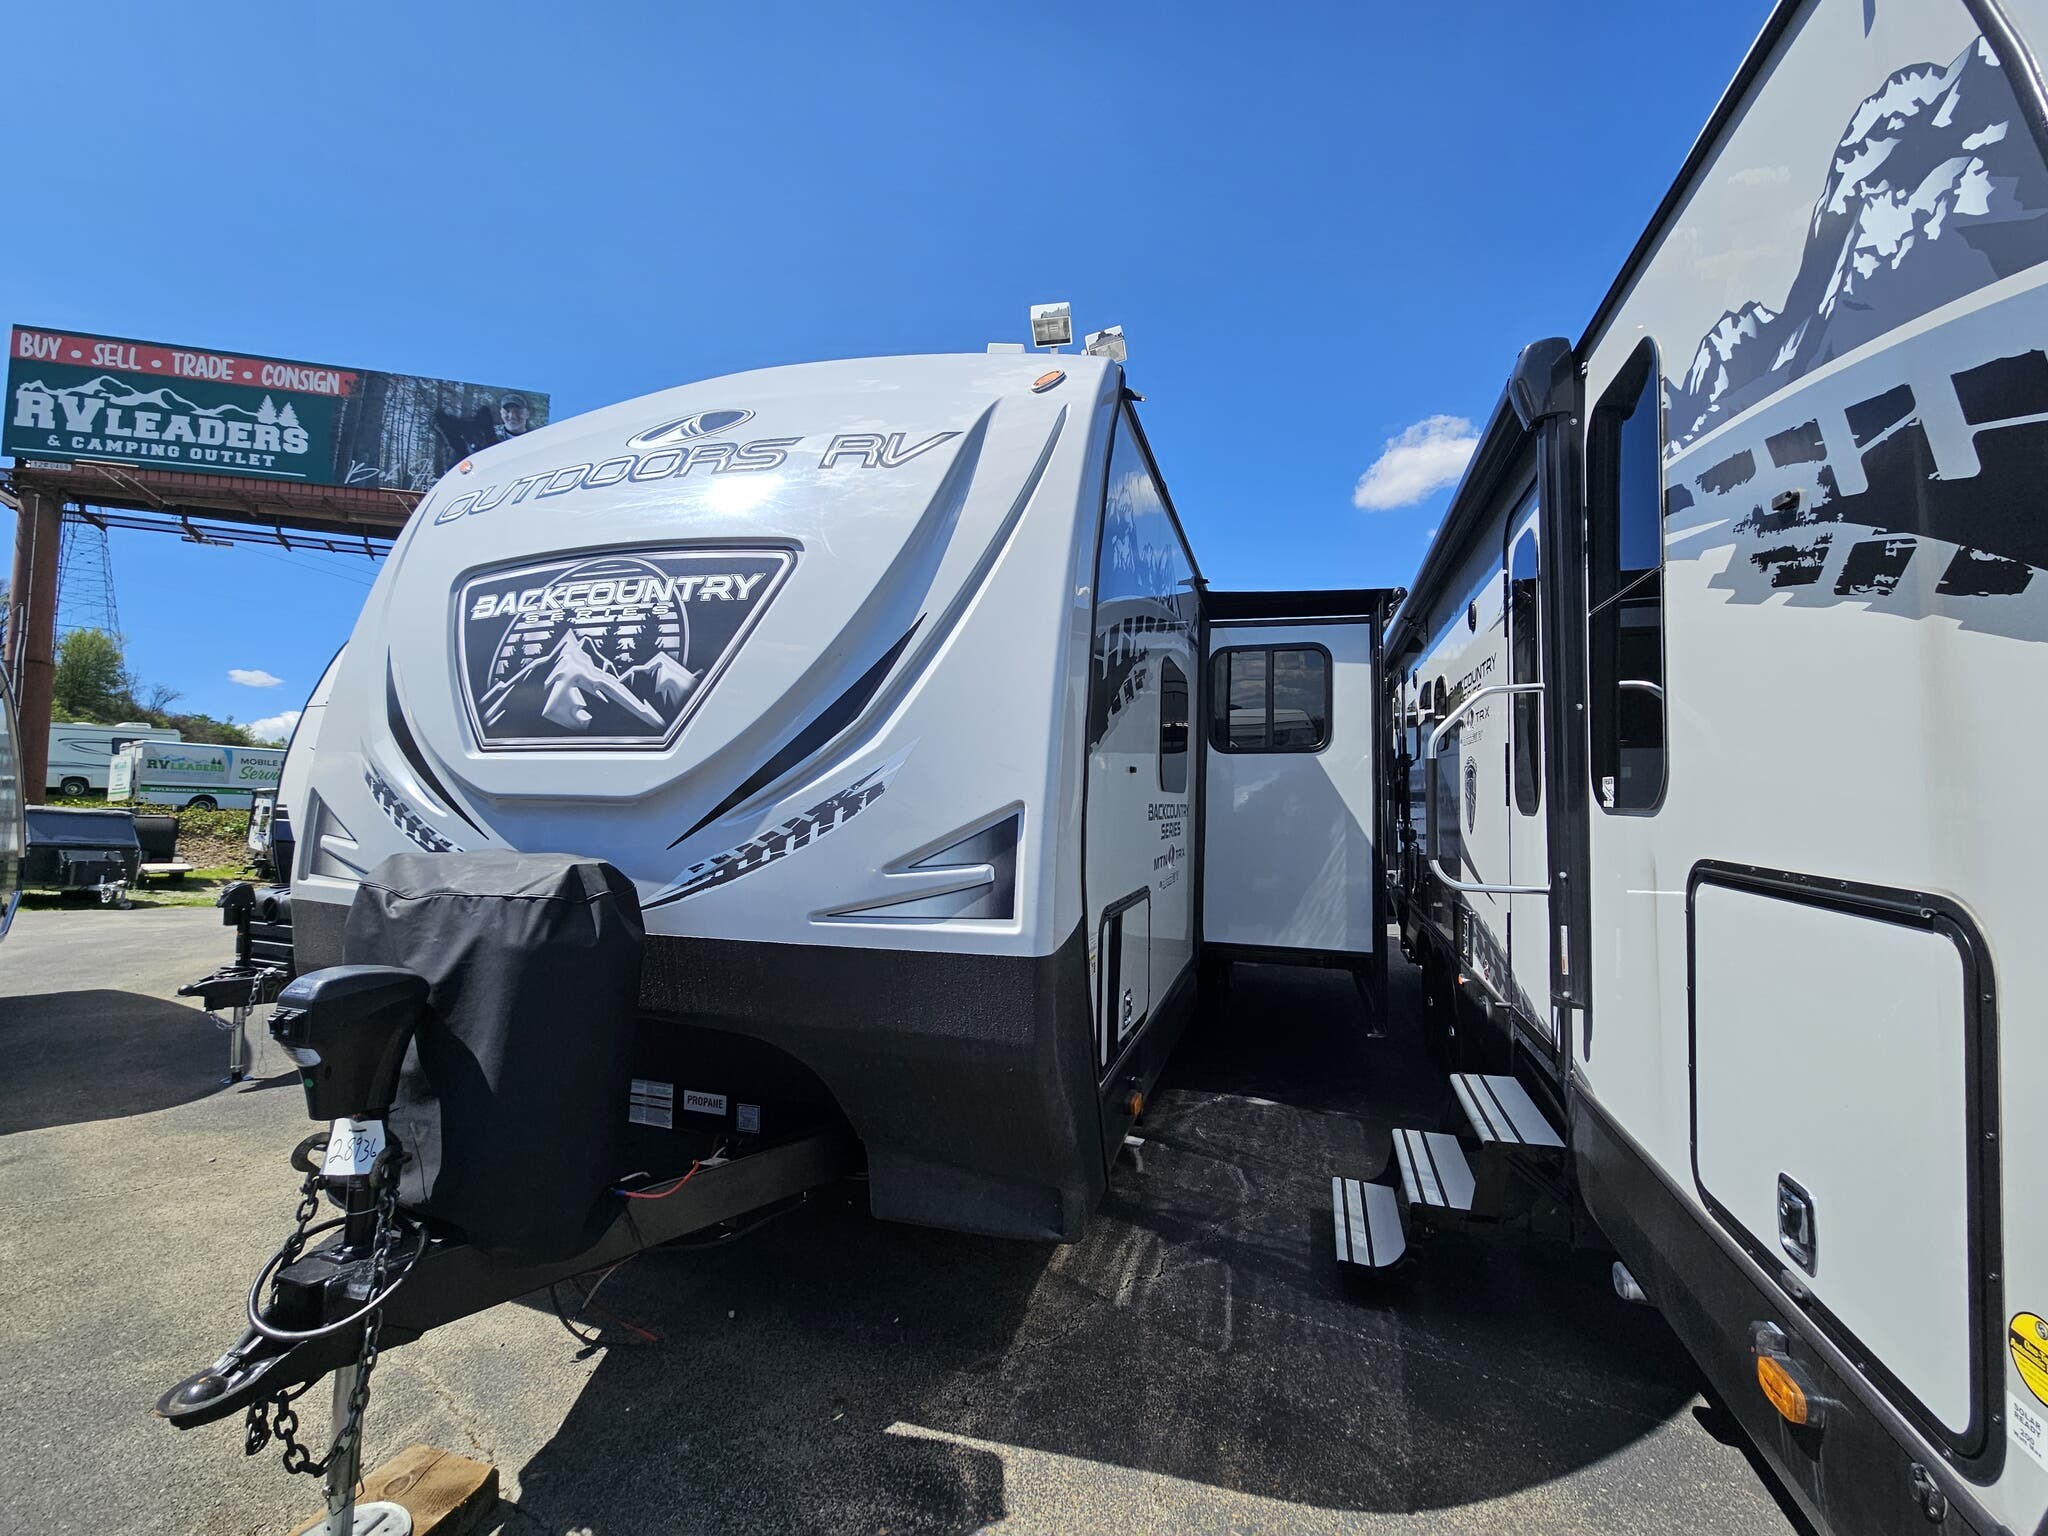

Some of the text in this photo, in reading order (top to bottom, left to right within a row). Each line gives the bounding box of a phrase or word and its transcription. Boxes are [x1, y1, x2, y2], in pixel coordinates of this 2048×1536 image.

[19, 332, 340, 395] BUY SELL TRADE CONSIGN
[47, 435, 276, 467] & CAMPING OUTLET
[434, 436, 805, 526] OUTDOORS
[819, 431, 964, 469] RV
[470, 572, 766, 620] BACKCOUNTRY
[523, 604, 671, 624] SERIES
[1475, 706, 1490, 722] TRX
[240, 758, 278, 767] MOBILE
[1148, 803, 1190, 821] BACKCOUNTRY
[1161, 821, 1181, 840] SERIES
[687, 1094, 723, 1110] PROPANE
[328, 1137, 377, 1164] 28936
[2014, 1402, 2042, 1431] SOLAR
[2014, 1411, 2042, 1438] READY
